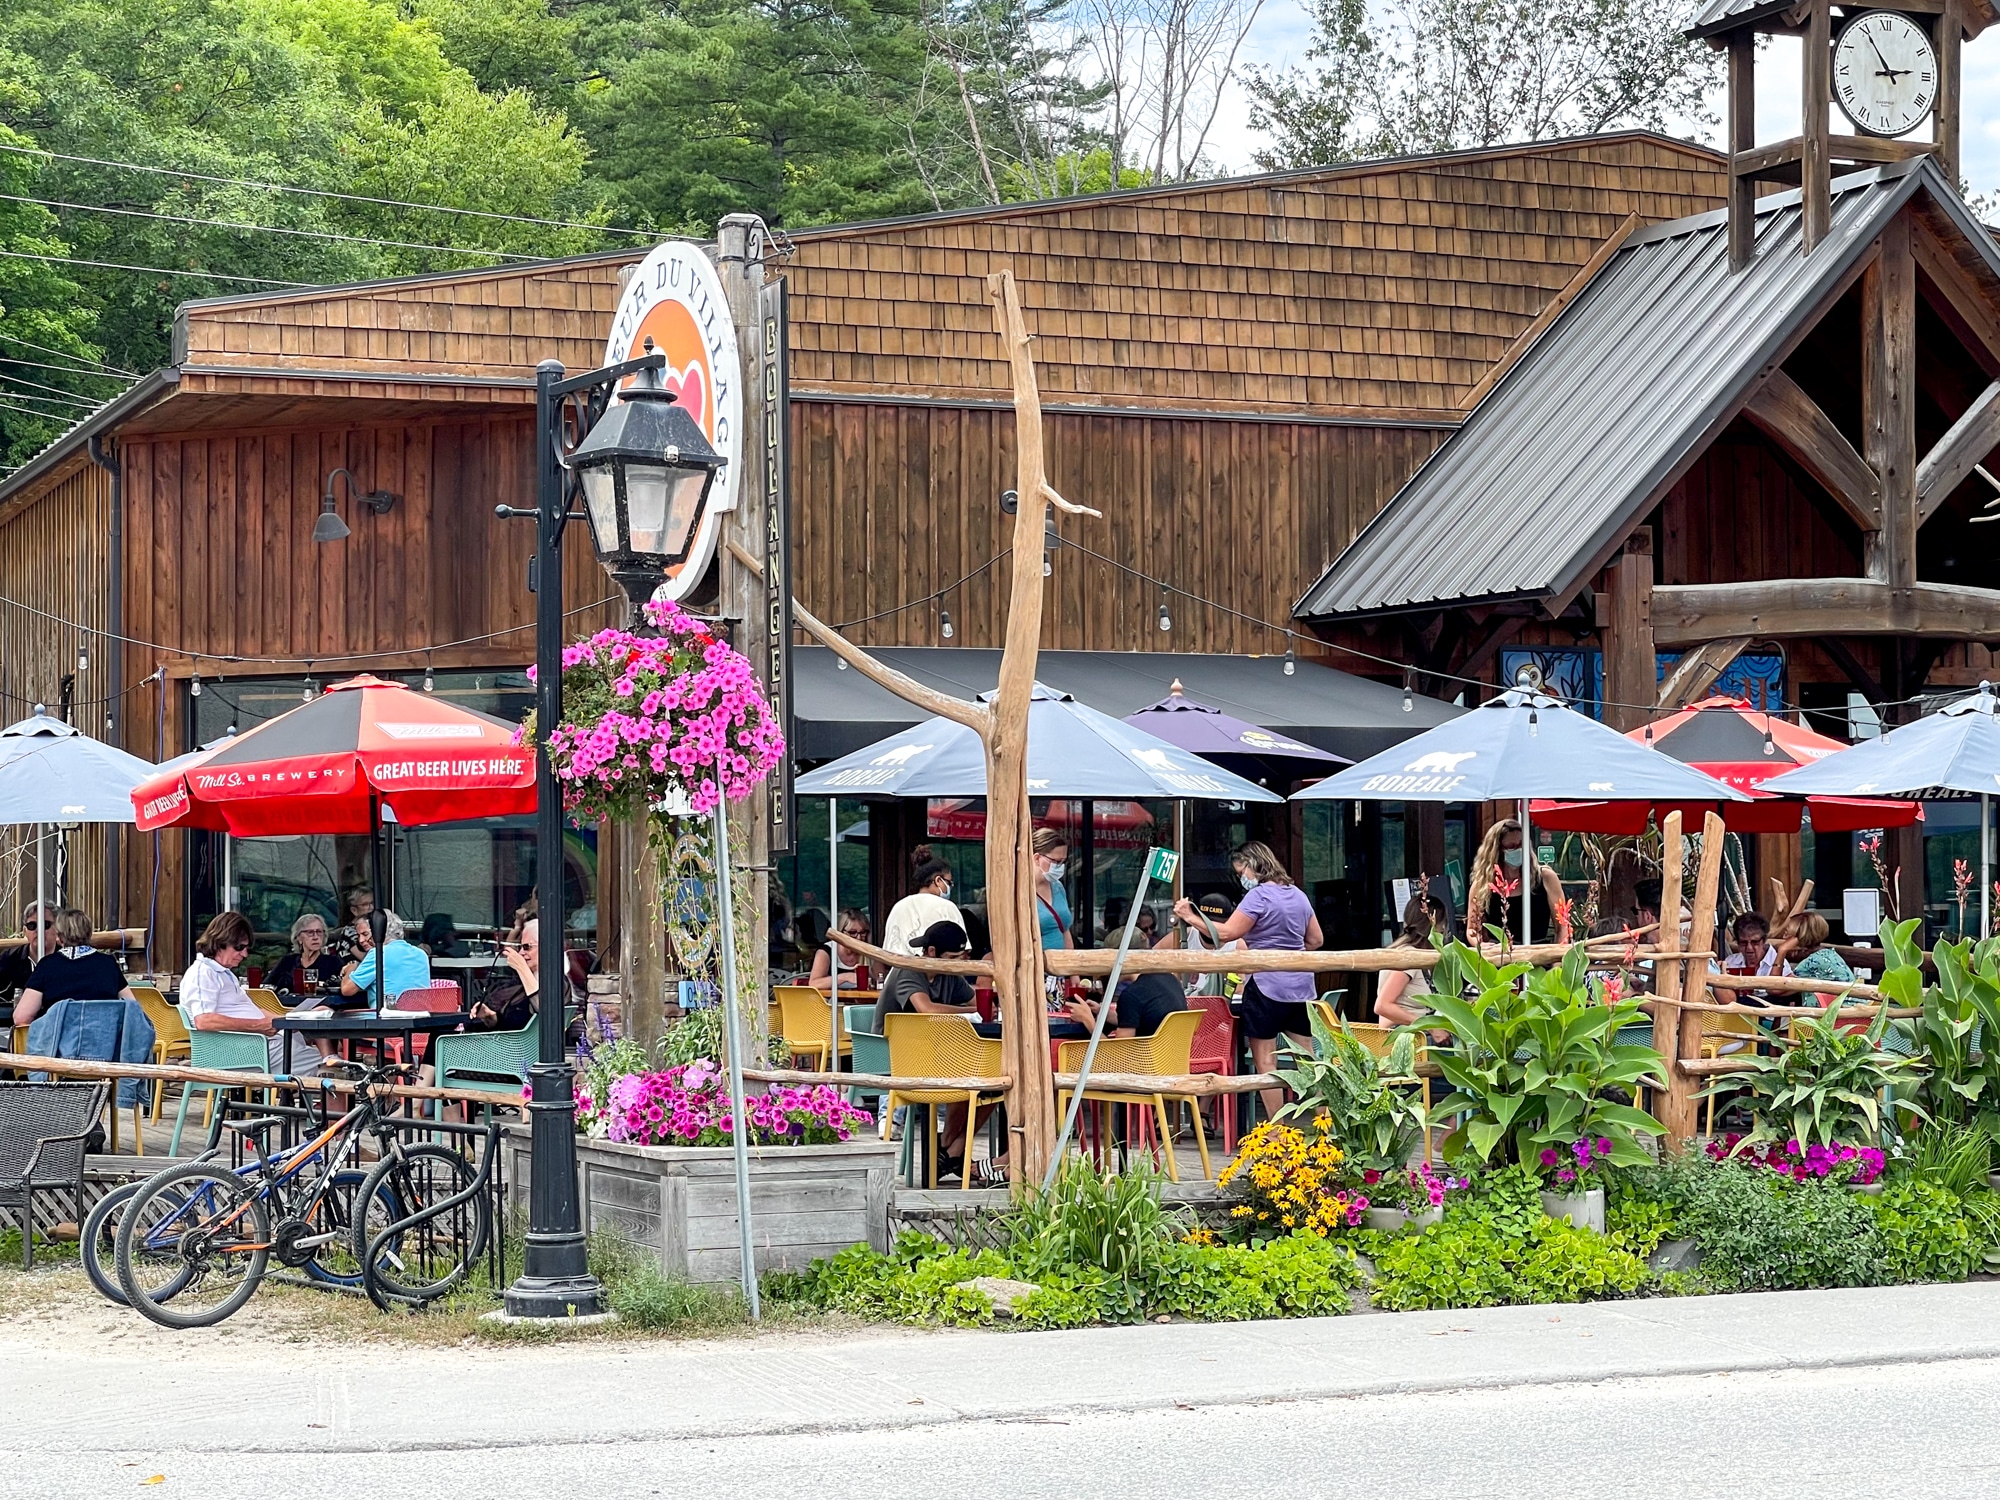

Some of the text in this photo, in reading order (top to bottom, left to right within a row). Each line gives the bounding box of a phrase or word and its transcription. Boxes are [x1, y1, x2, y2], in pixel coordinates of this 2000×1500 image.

[656, 258, 683, 290] DU
[688, 267, 729, 486] VILLAGE
[196, 769, 345, 788] Mill St. BREWERY
[373, 762, 415, 780] GREAT
[416, 761, 450, 777] BEER
[452, 760, 486, 776] LIVES
[1361, 775, 1466, 793] BOREALE
[1880, 787, 1973, 799] OREAL
[1156, 851, 1179, 881] 757
[320, 1128, 359, 1191] TREK
